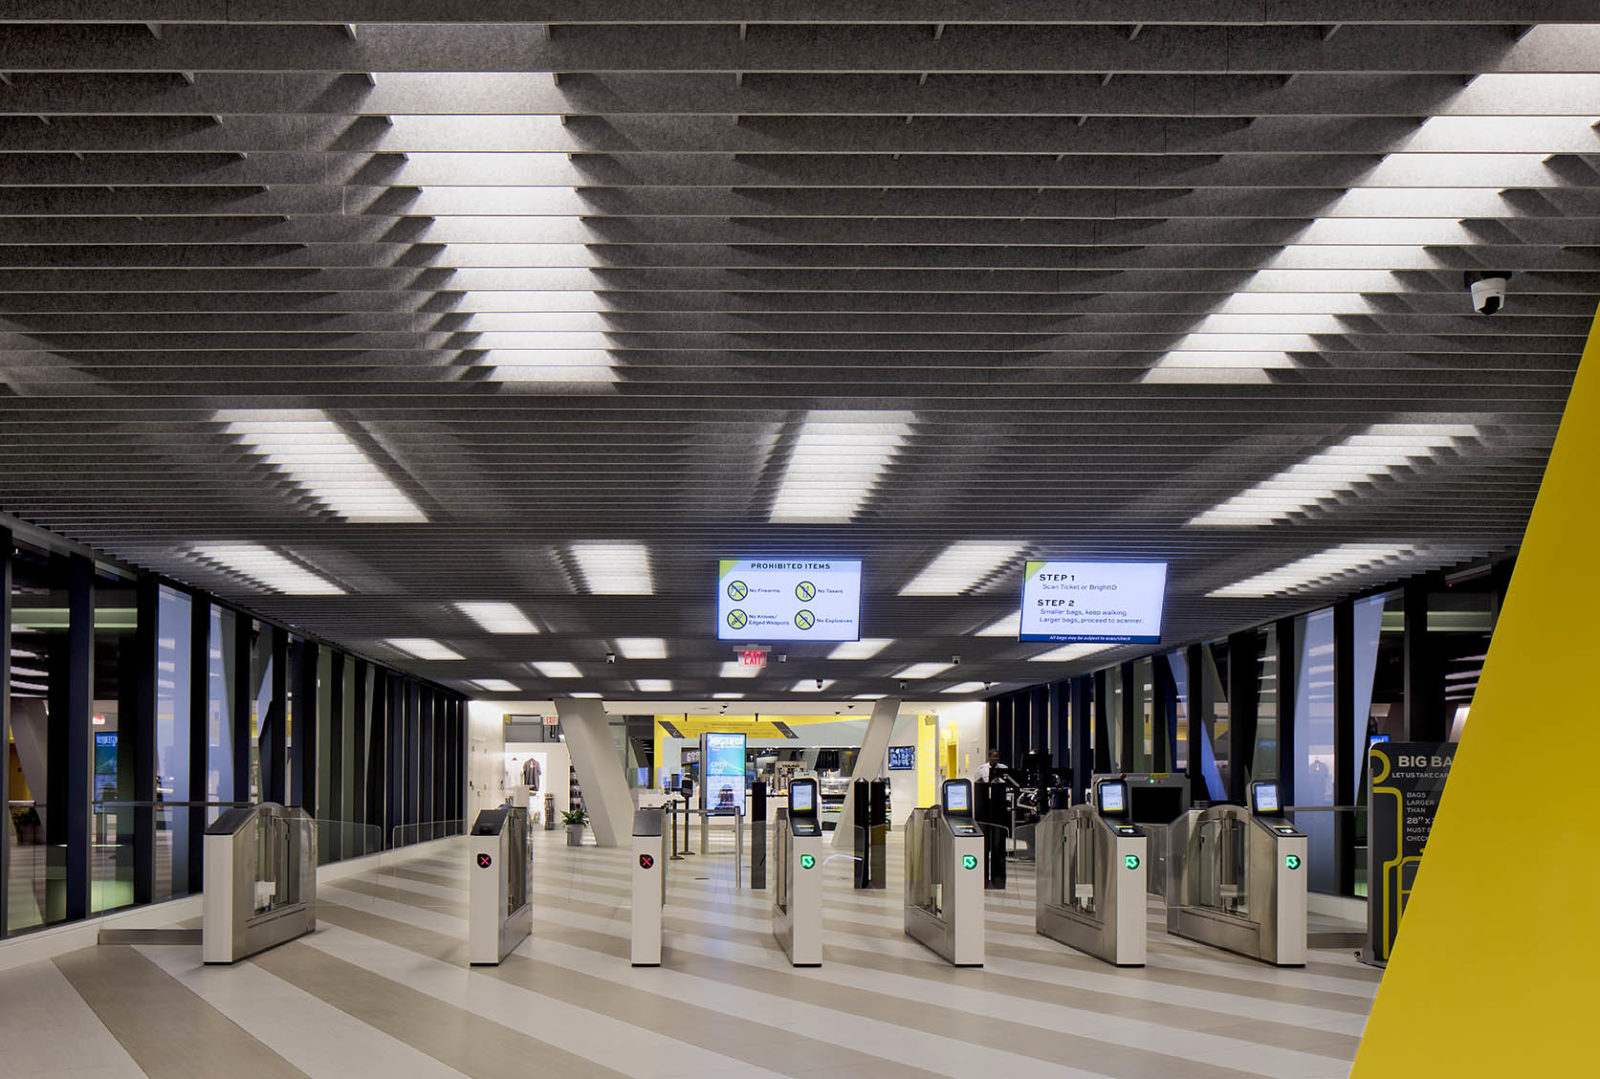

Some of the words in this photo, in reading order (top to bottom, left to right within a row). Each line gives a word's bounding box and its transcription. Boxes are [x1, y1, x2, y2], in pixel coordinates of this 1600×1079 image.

[751, 562, 803, 570] PROHIBITED
[1039, 573, 1068, 581] STEP
[1037, 599, 1066, 607] STEP
[743, 650, 761, 665] EXIT
[1398, 755, 1428, 768] BIG
[1431, 755, 1453, 768] BA
